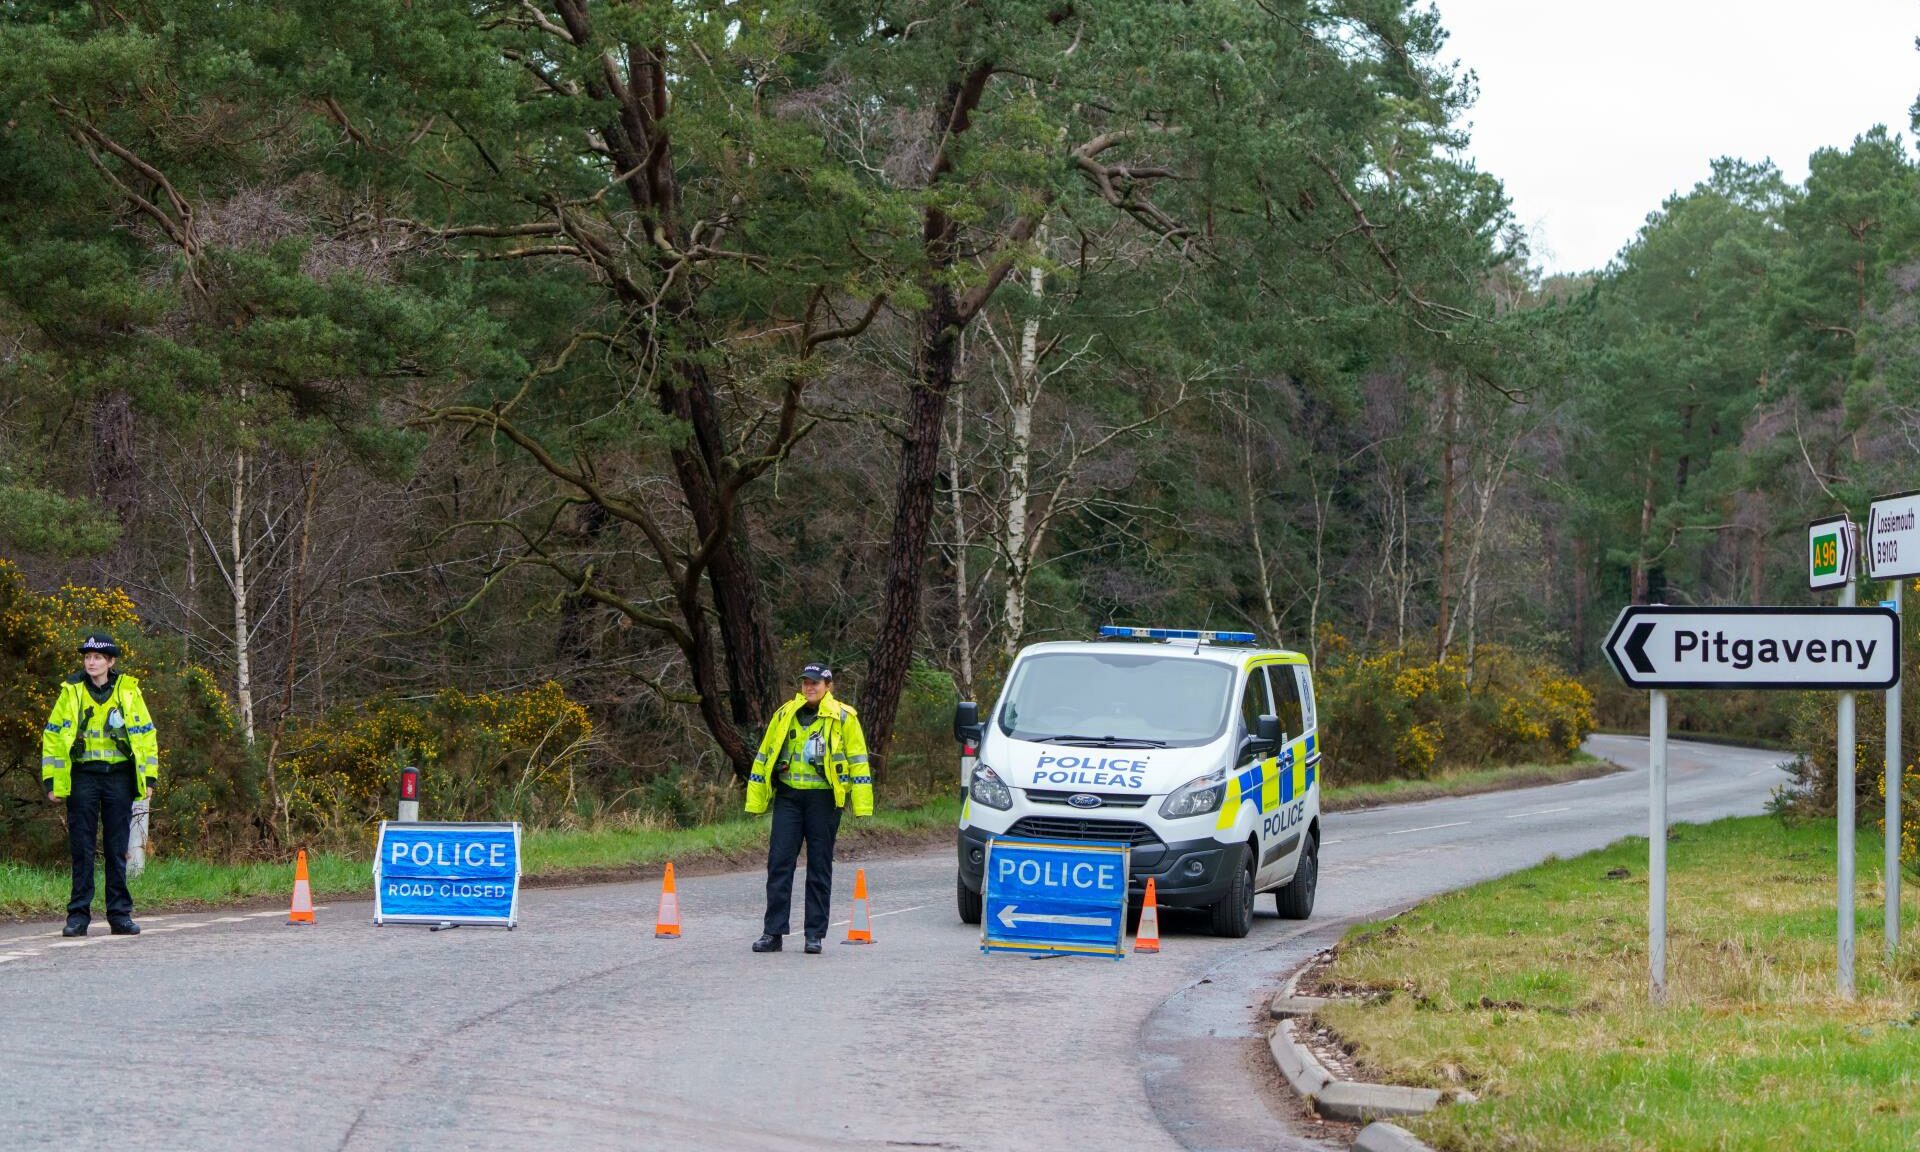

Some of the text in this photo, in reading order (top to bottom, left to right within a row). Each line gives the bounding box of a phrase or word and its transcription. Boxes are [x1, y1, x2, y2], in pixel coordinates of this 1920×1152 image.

[1877, 507, 1915, 534] Lossiemouth
[1674, 630, 1877, 669] Pitgaveny
[1037, 756, 1148, 773] POLICE
[1032, 771, 1143, 788] POILEAS
[1263, 800, 1304, 841] POLICE
[391, 841, 506, 867] POLICE
[998, 858, 1115, 890] POLICE
[388, 884, 506, 898] ROAD CLOSED
